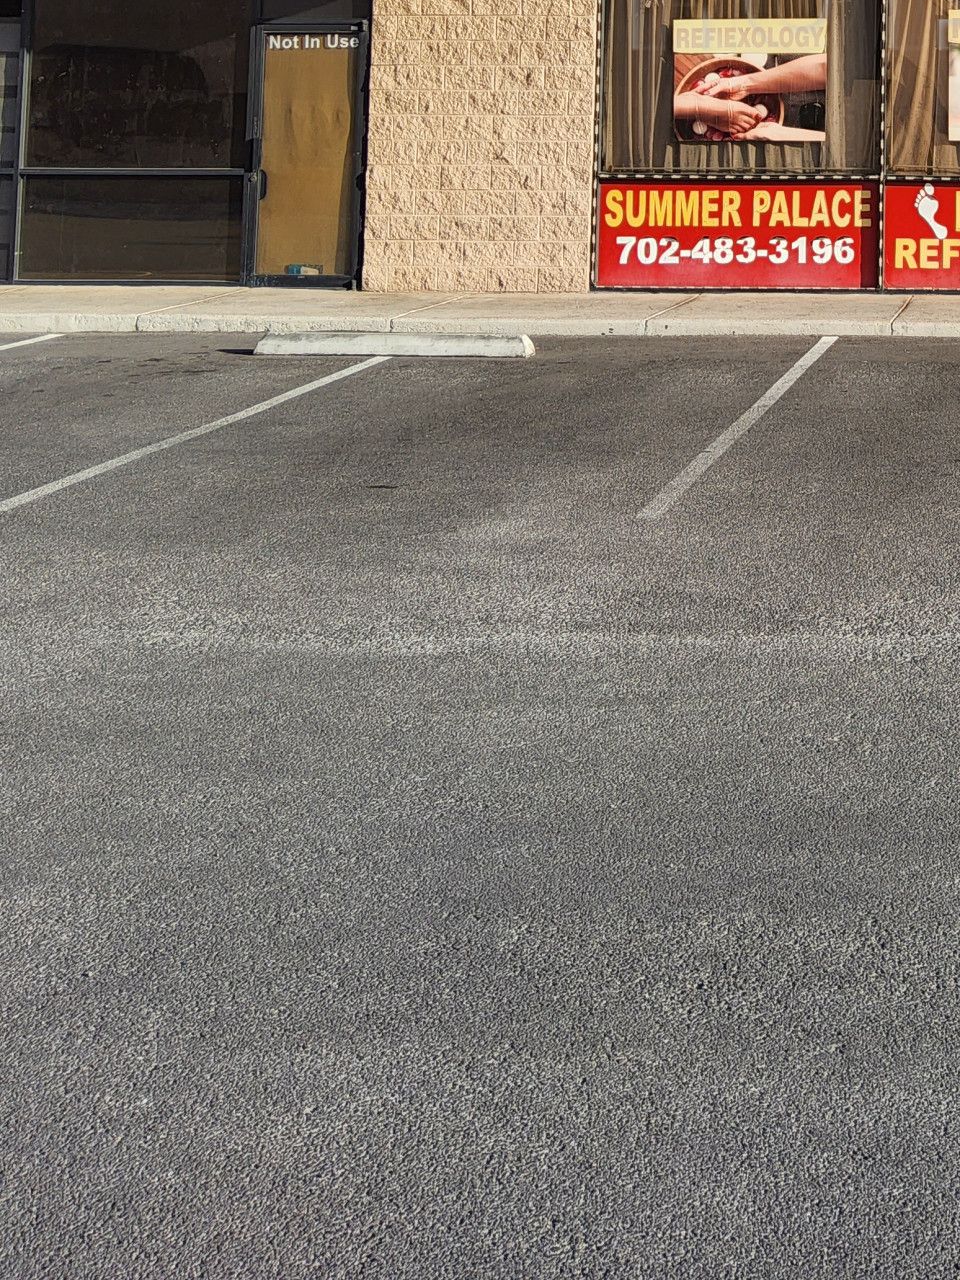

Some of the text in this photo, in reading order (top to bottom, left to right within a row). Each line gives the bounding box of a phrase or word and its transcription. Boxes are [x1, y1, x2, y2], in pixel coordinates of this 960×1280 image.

[269, 33, 359, 49] Not In Use
[604, 189, 872, 228] SUMMER PALACE
[616, 236, 855, 265] 702-483-3196
